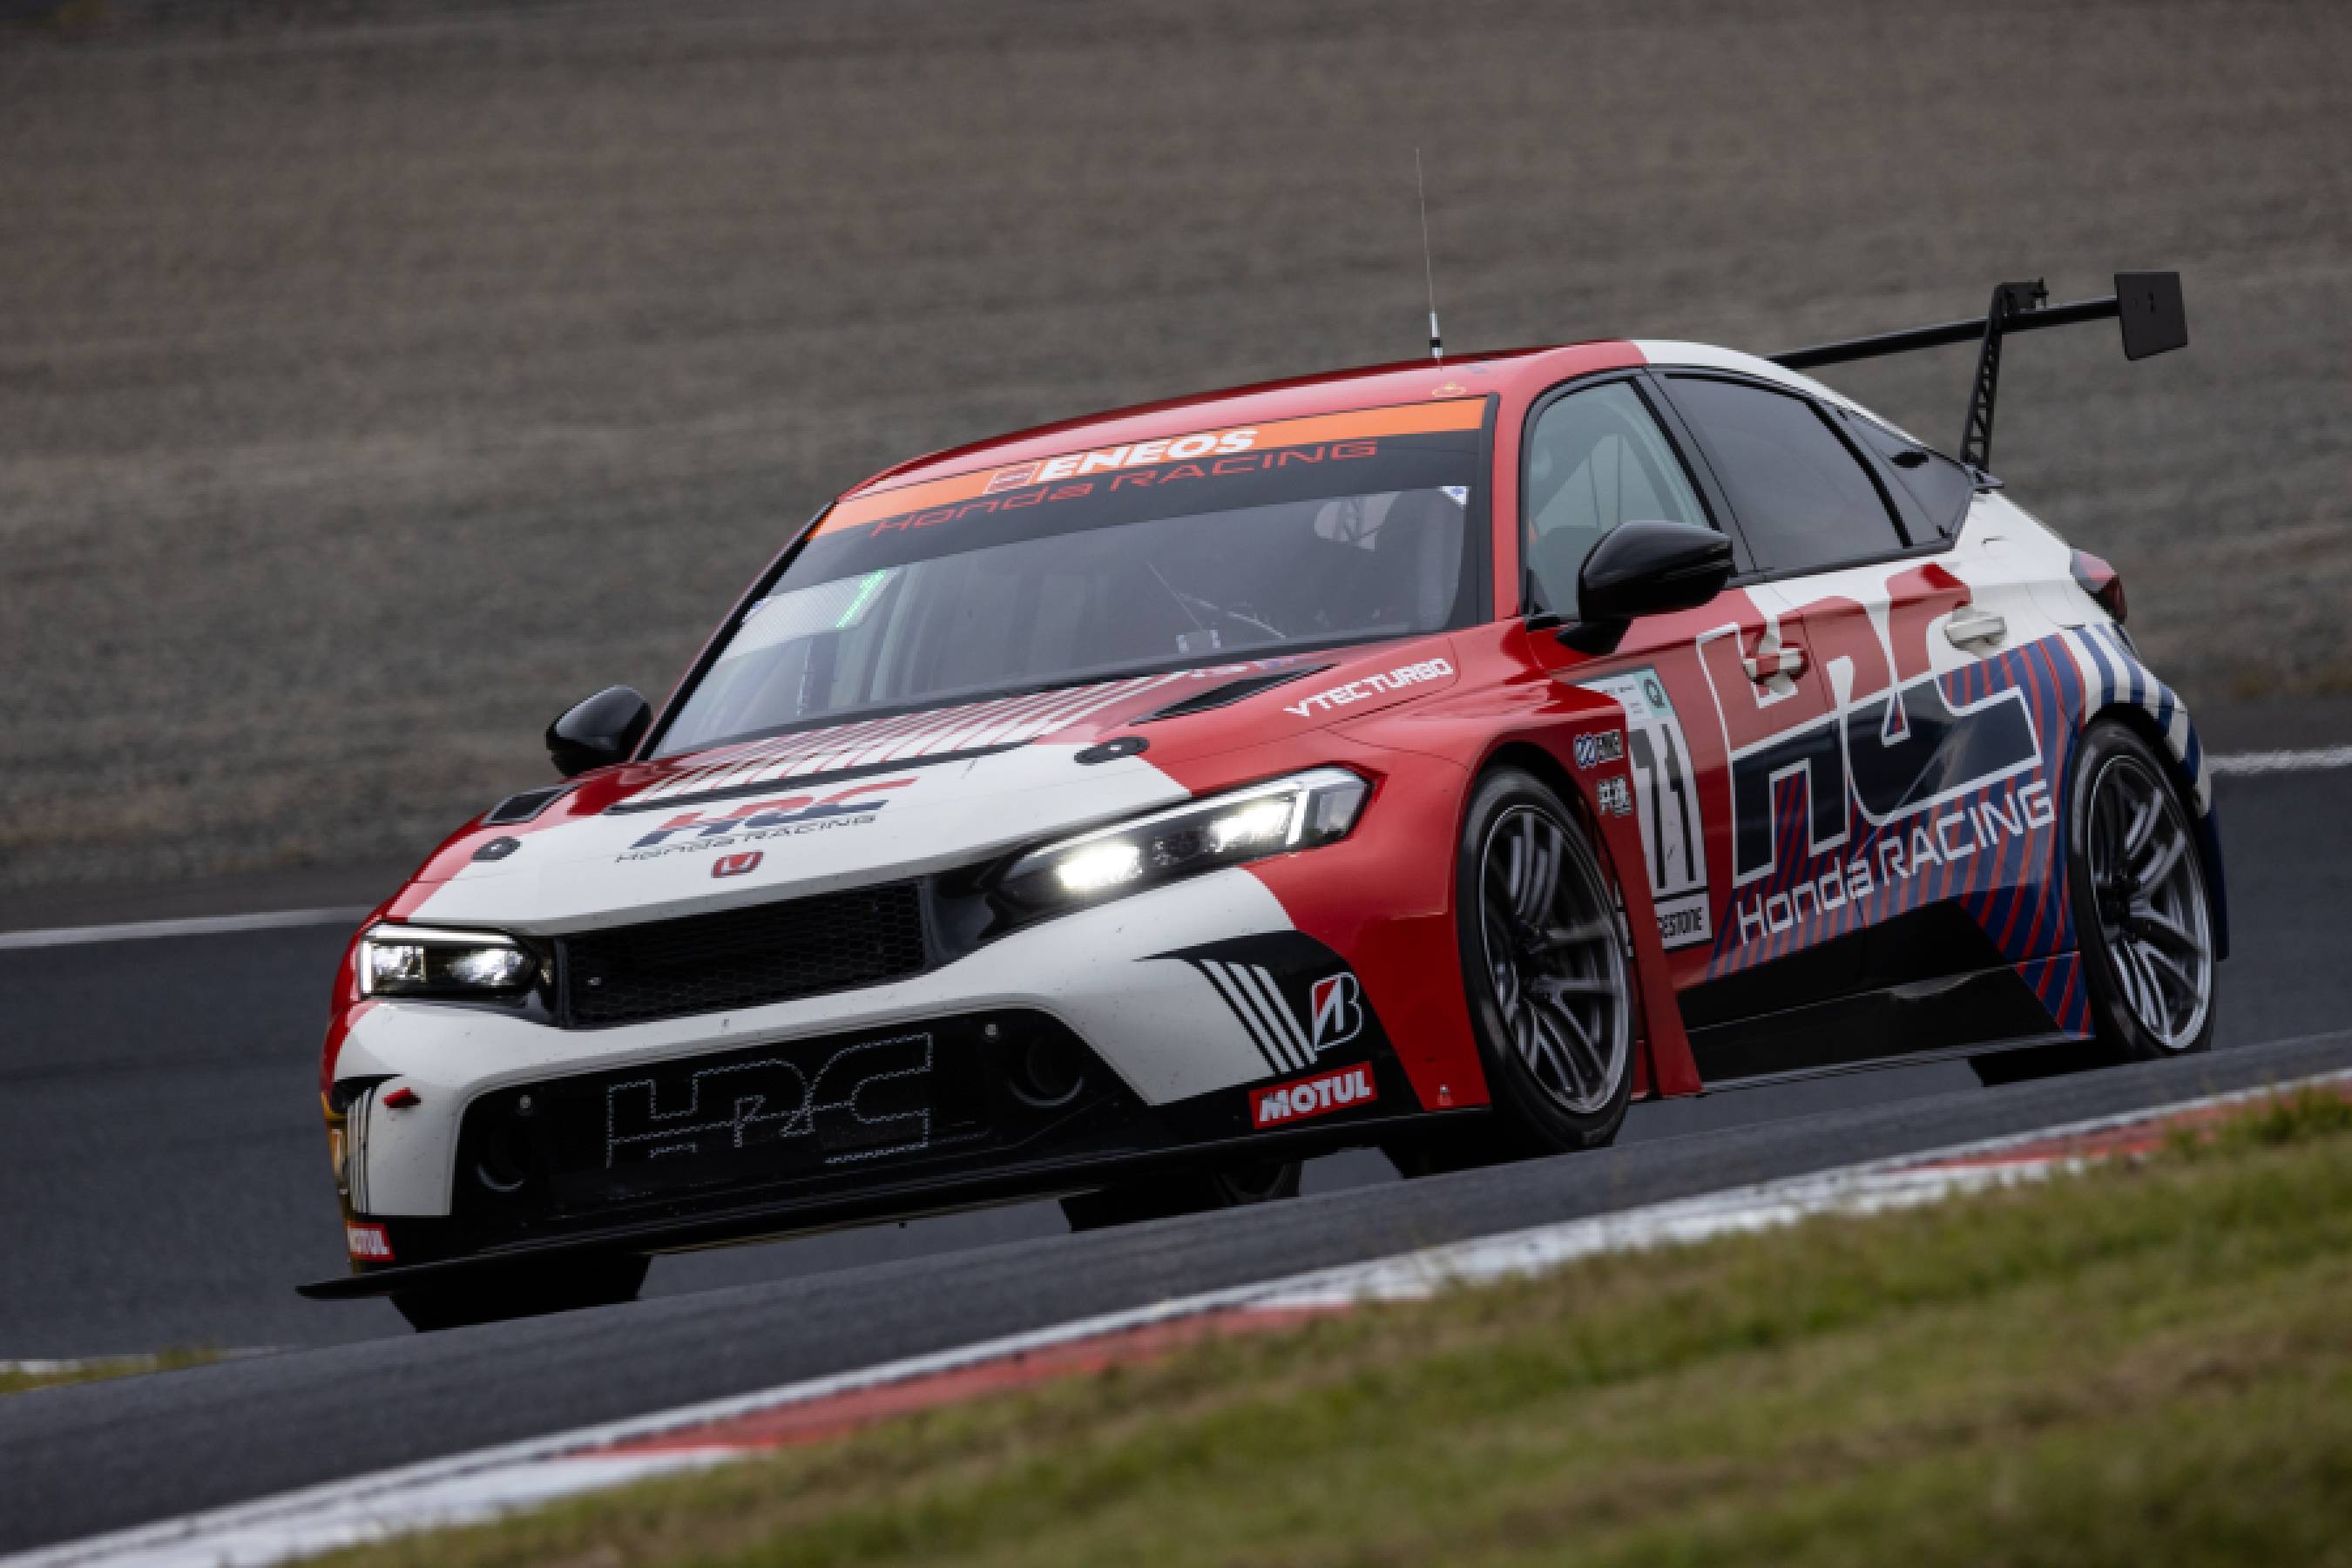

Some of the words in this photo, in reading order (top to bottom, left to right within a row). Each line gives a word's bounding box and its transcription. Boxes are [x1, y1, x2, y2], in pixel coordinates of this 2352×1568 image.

[870, 482, 1094, 537] Honda
[1109, 440, 1378, 492] RACING
[1037, 429, 1260, 482] ENEOS
[1696, 562, 2044, 889] HRC
[613, 832, 734, 862] Honda
[743, 814, 875, 842] RACING
[1737, 856, 1875, 946] Honda
[1878, 779, 2055, 887] RACING
[1259, 1069, 1371, 1122] MOTUL
